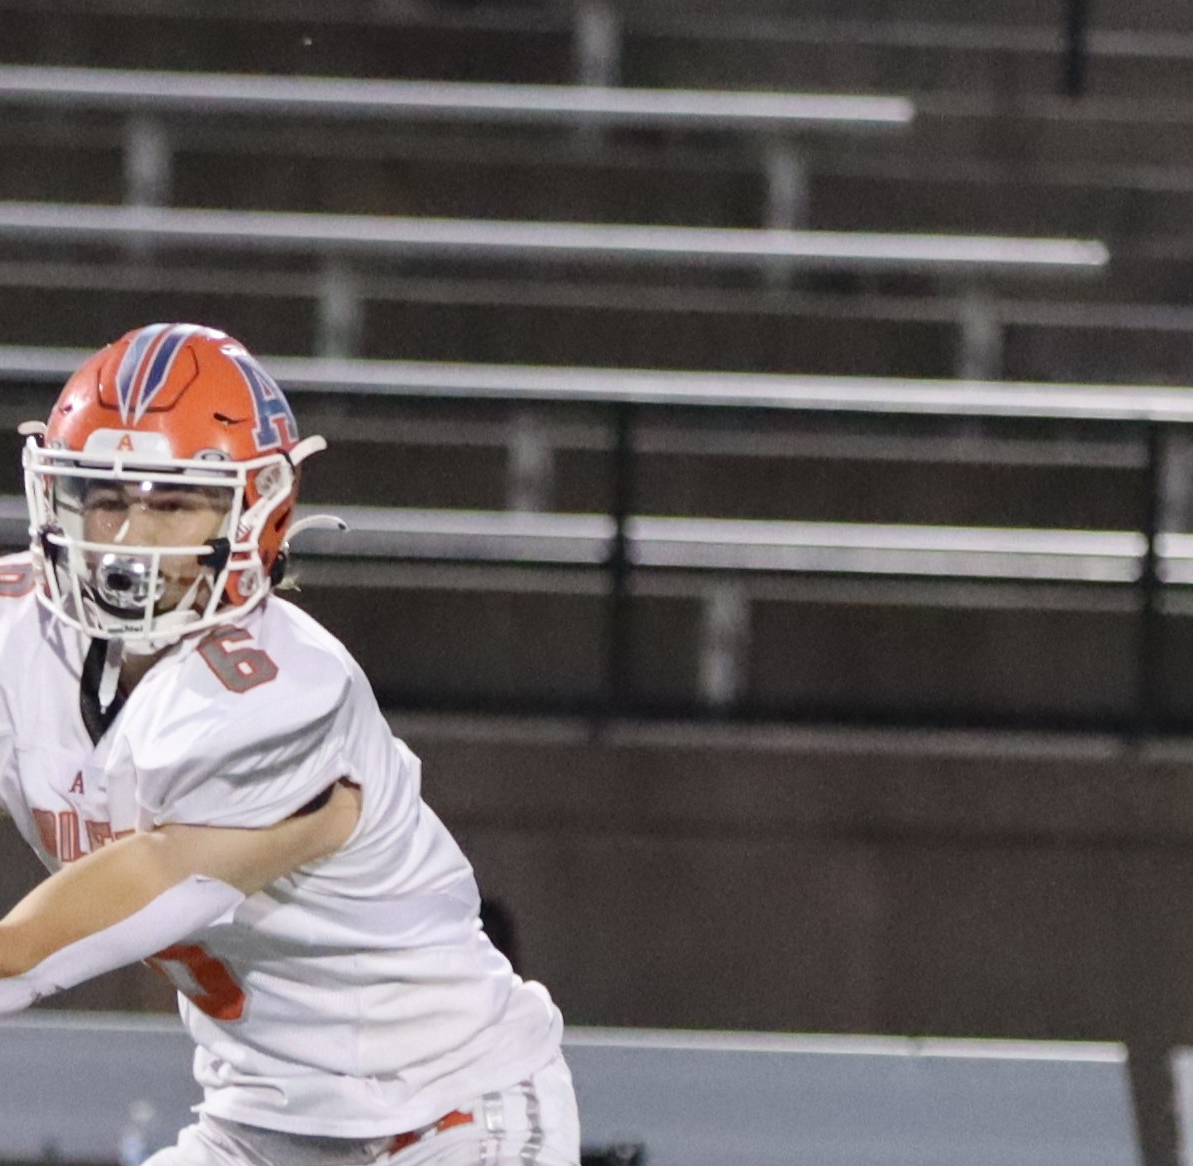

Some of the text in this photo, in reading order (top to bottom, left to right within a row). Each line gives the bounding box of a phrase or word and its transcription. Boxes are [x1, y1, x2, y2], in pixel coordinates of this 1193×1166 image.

[220, 346, 299, 451] A
[116, 433, 135, 451] A
[198, 623, 279, 694] 6
[68, 769, 85, 795] A
